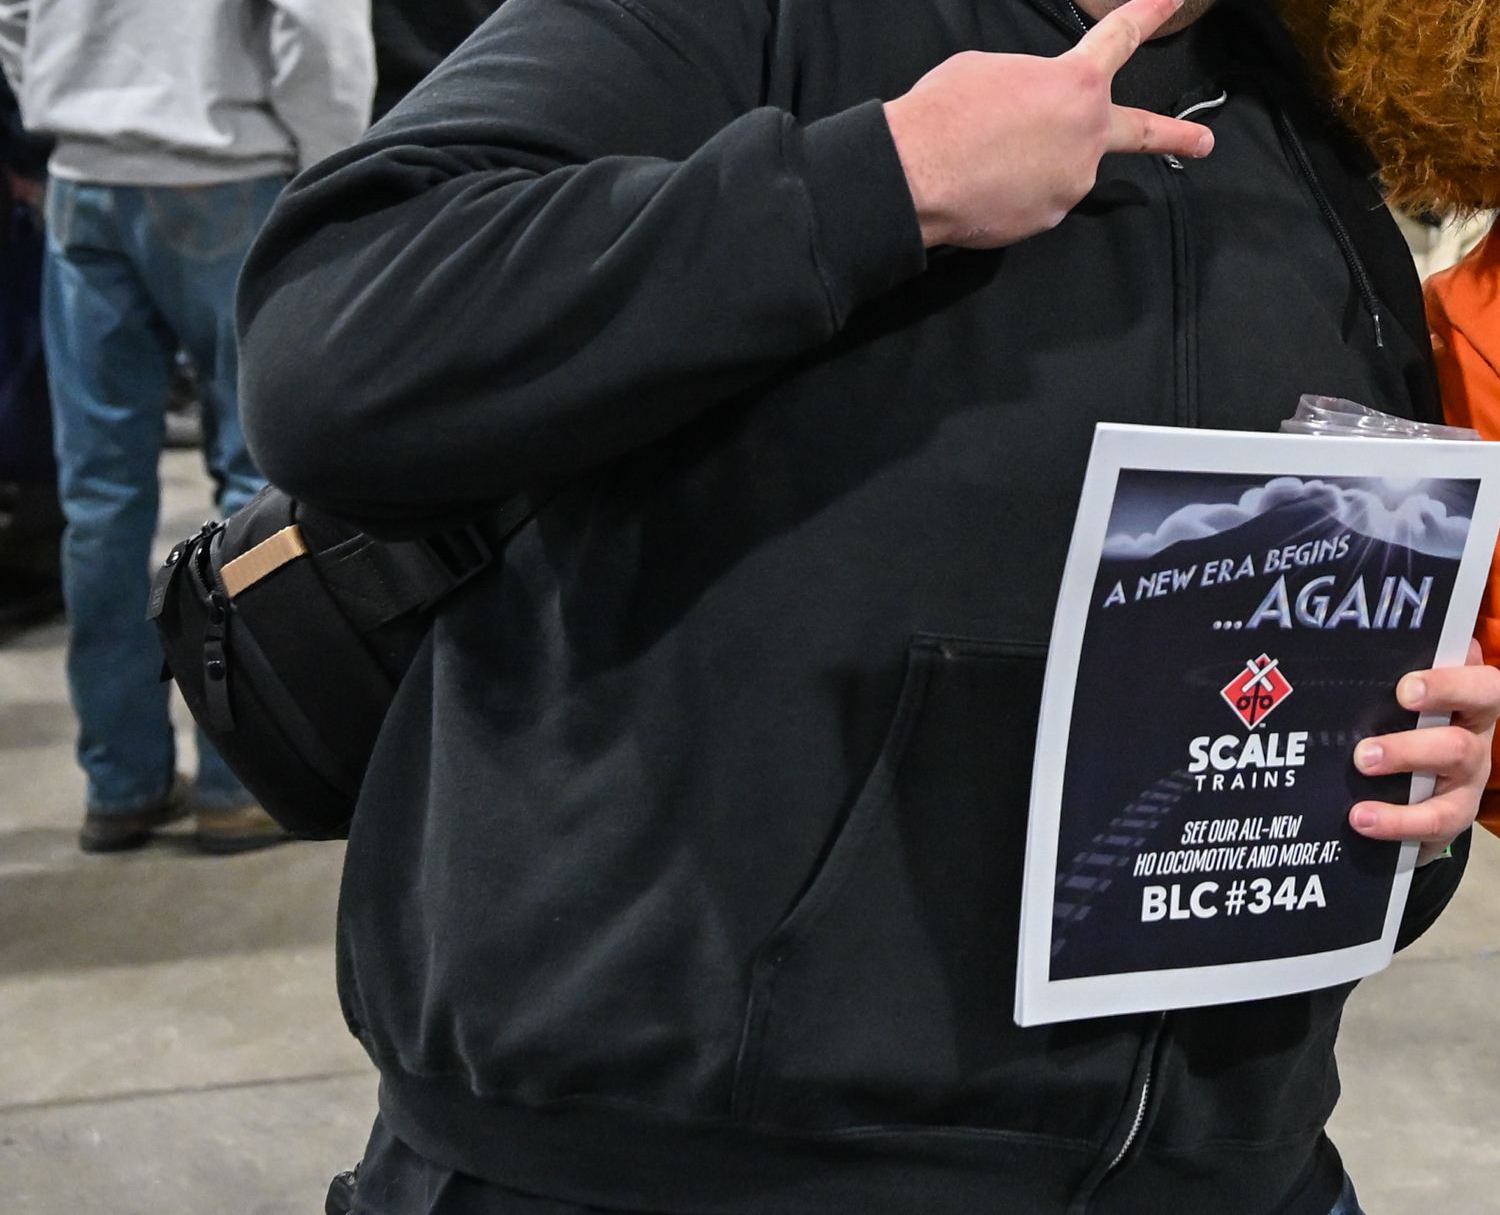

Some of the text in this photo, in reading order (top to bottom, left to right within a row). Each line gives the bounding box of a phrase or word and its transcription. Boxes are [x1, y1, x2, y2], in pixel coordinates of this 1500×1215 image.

[1103, 535, 1352, 608] A NEW ERA BEGINS
[1188, 732, 1308, 772] SCALE
[1195, 770, 1296, 792] TRAINS
[1181, 815, 1303, 845] SEE OUR ALL-NEW
[1133, 840, 1342, 877] HO LOCOMOTIVE AND MORE AT:
[1141, 874, 1327, 923] BLC #34A
